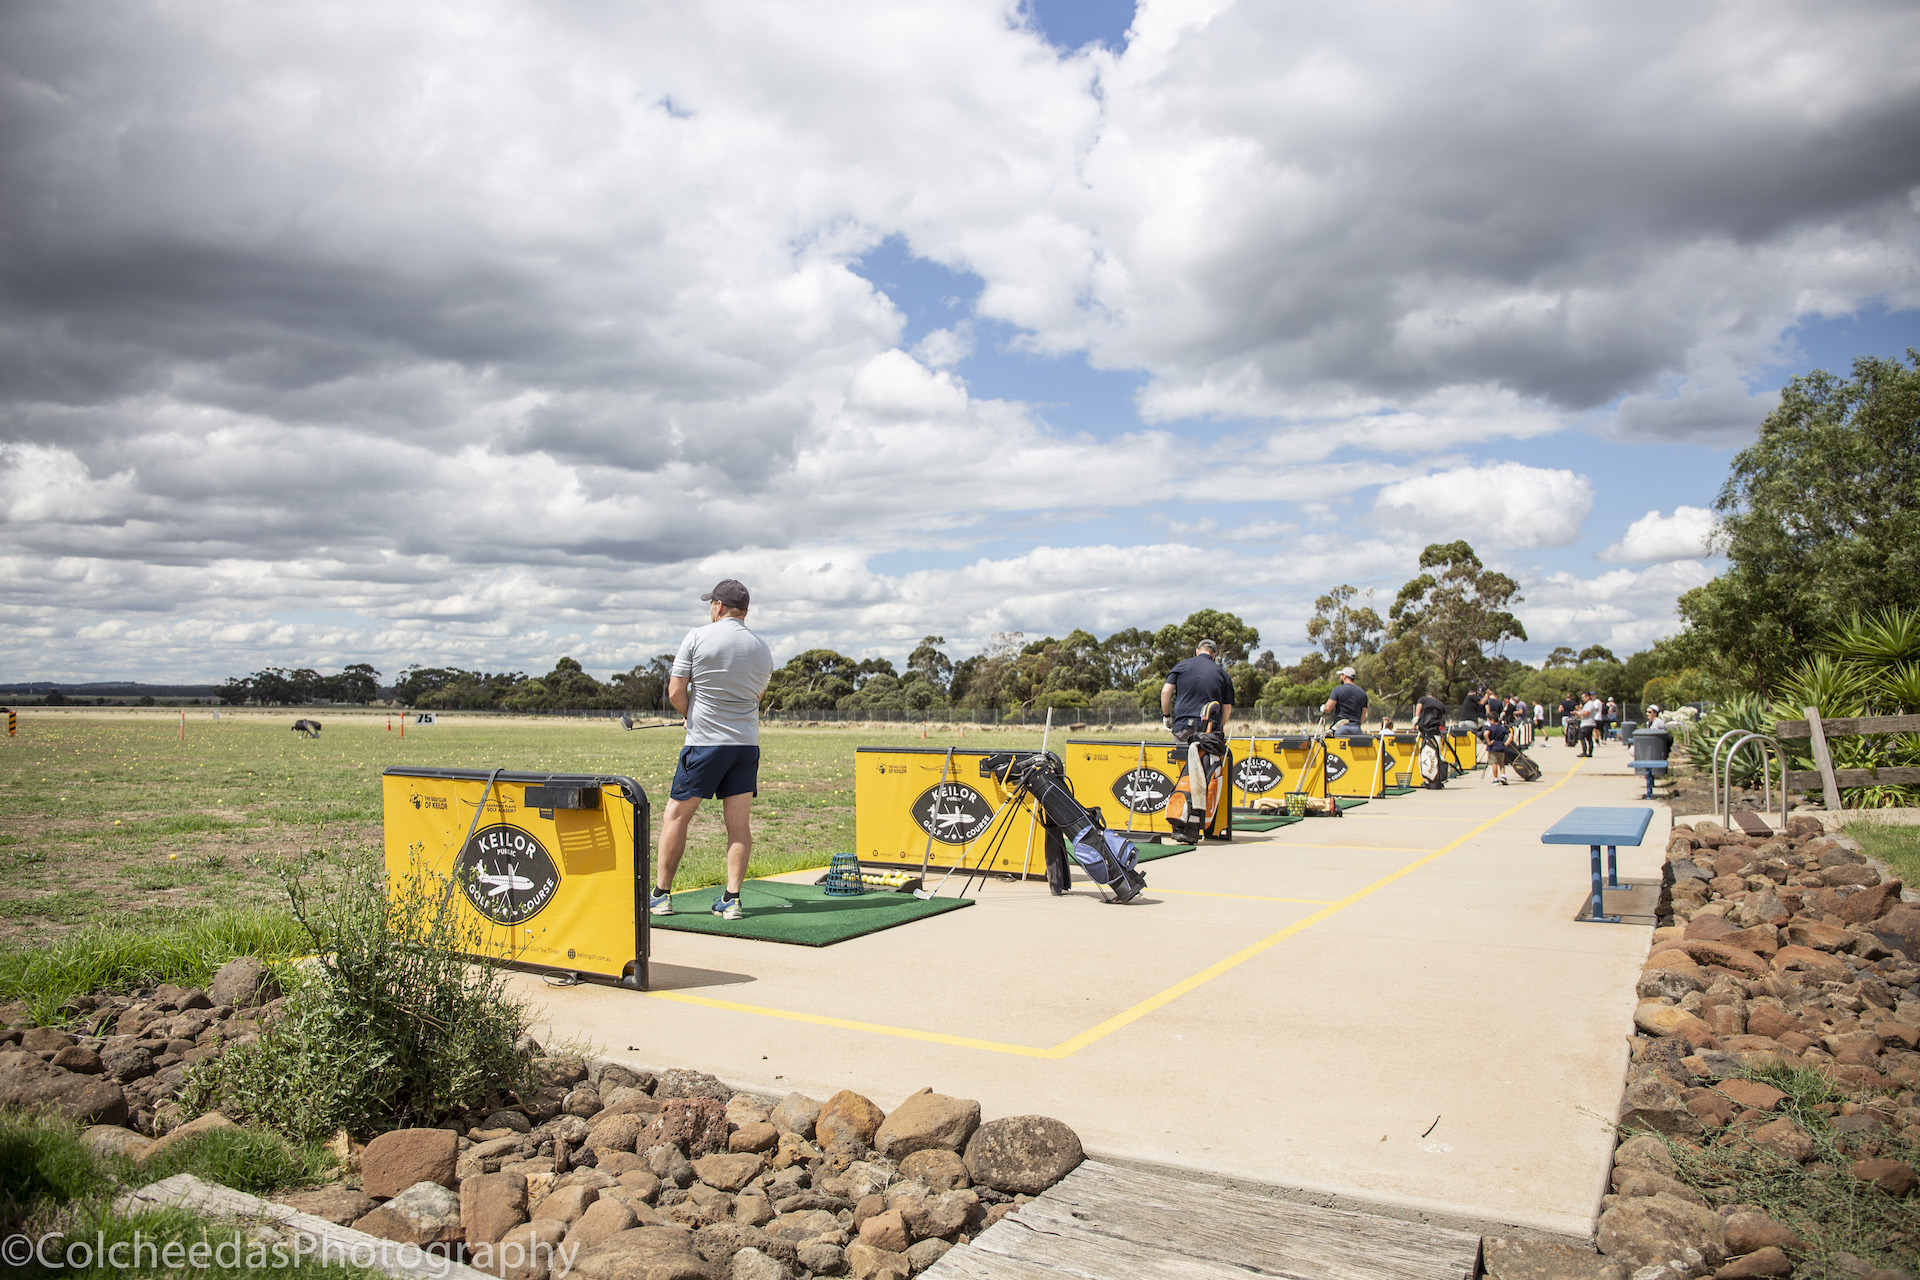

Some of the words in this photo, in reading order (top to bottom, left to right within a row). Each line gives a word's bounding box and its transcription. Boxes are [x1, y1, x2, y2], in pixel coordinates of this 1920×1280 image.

[418, 714, 432, 723] 75
[425, 801, 431, 809] OF
[432, 802, 448, 810] KEILOR
[966, 814, 991, 838] COURSE
[478, 832, 536, 859] KEILOR
[497, 848, 516, 857] PUBLIC
[468, 884, 490, 909] GOLF
[521, 877, 555, 914] COURSE
